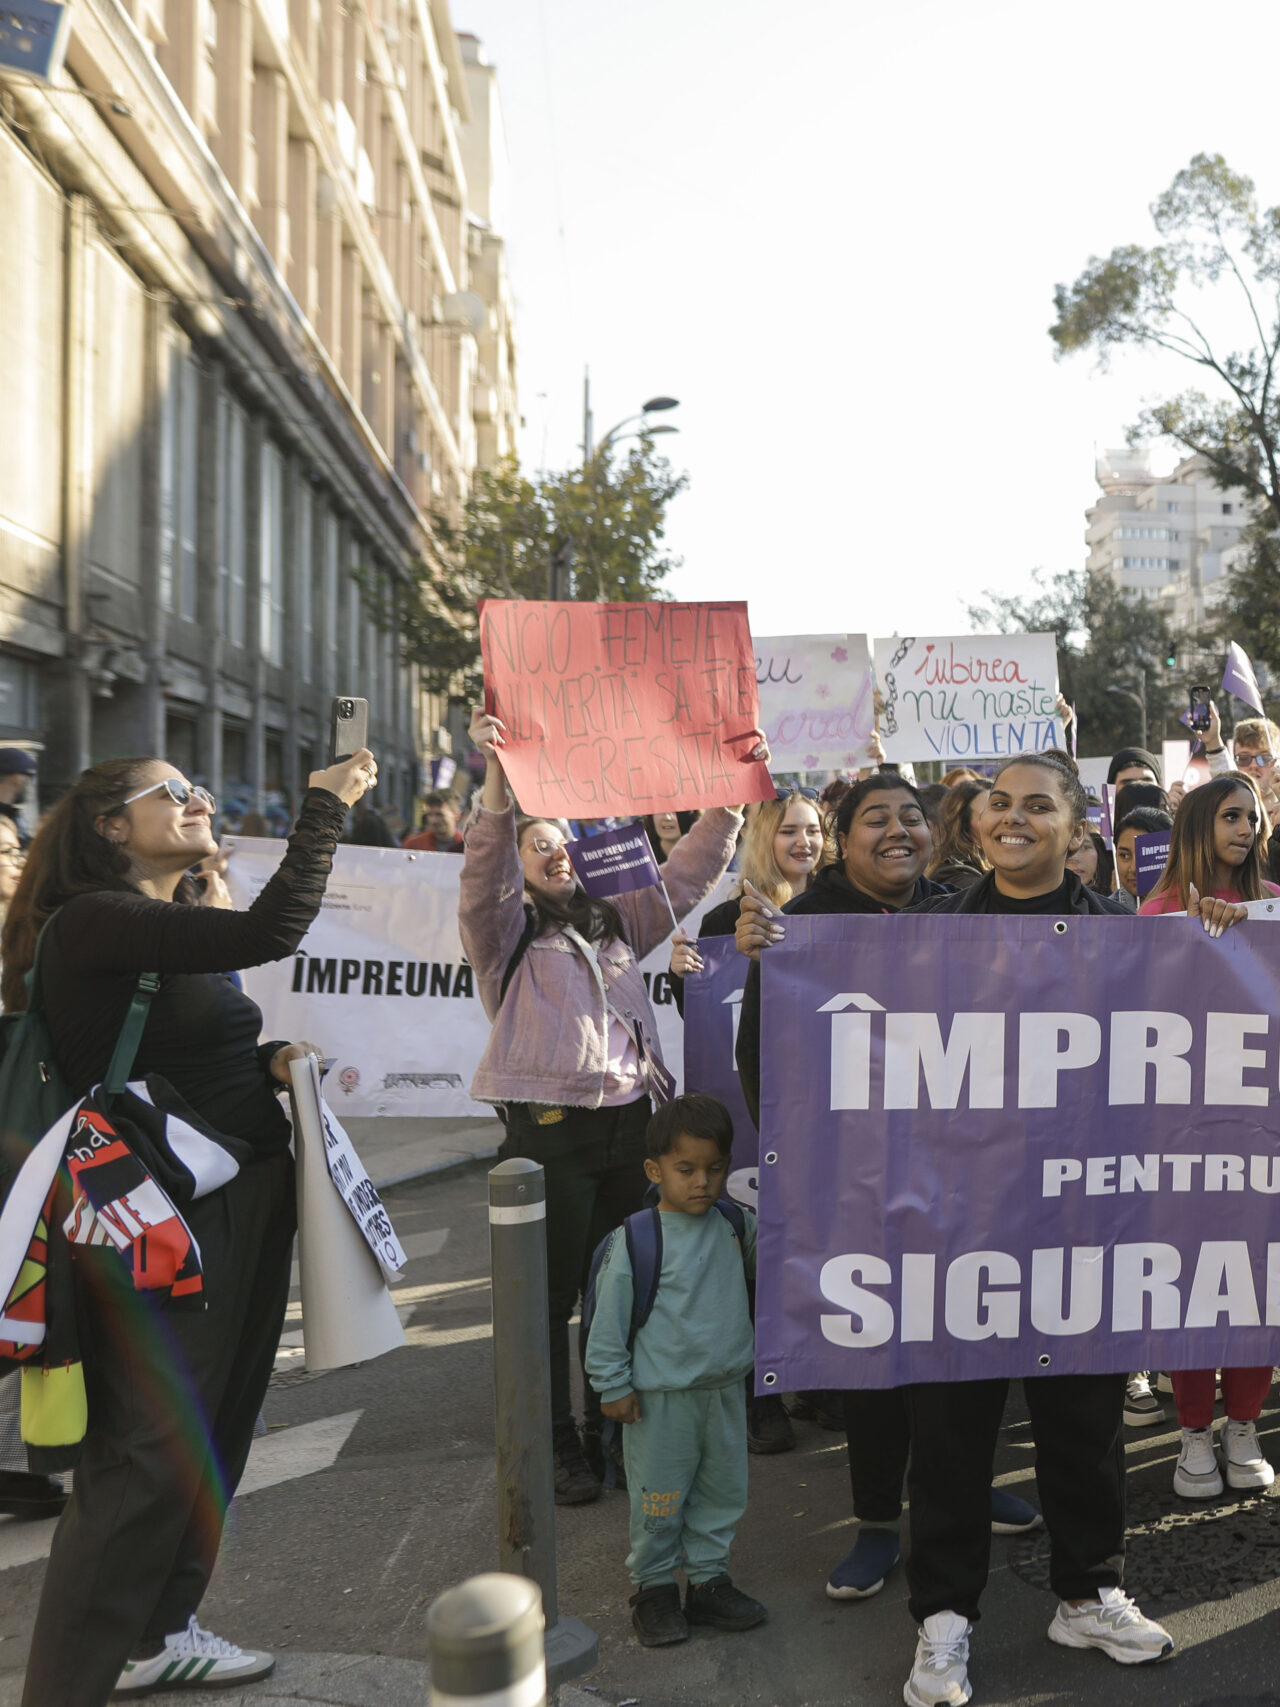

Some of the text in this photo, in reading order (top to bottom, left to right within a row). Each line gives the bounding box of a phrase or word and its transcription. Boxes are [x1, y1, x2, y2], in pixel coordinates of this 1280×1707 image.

[485, 603, 731, 675] NICIO FEMEIE
[915, 641, 1028, 686] iubirea
[491, 681, 534, 742] NU
[903, 690, 965, 722] nu
[291, 949, 475, 998] ÎMPREUNĂ
